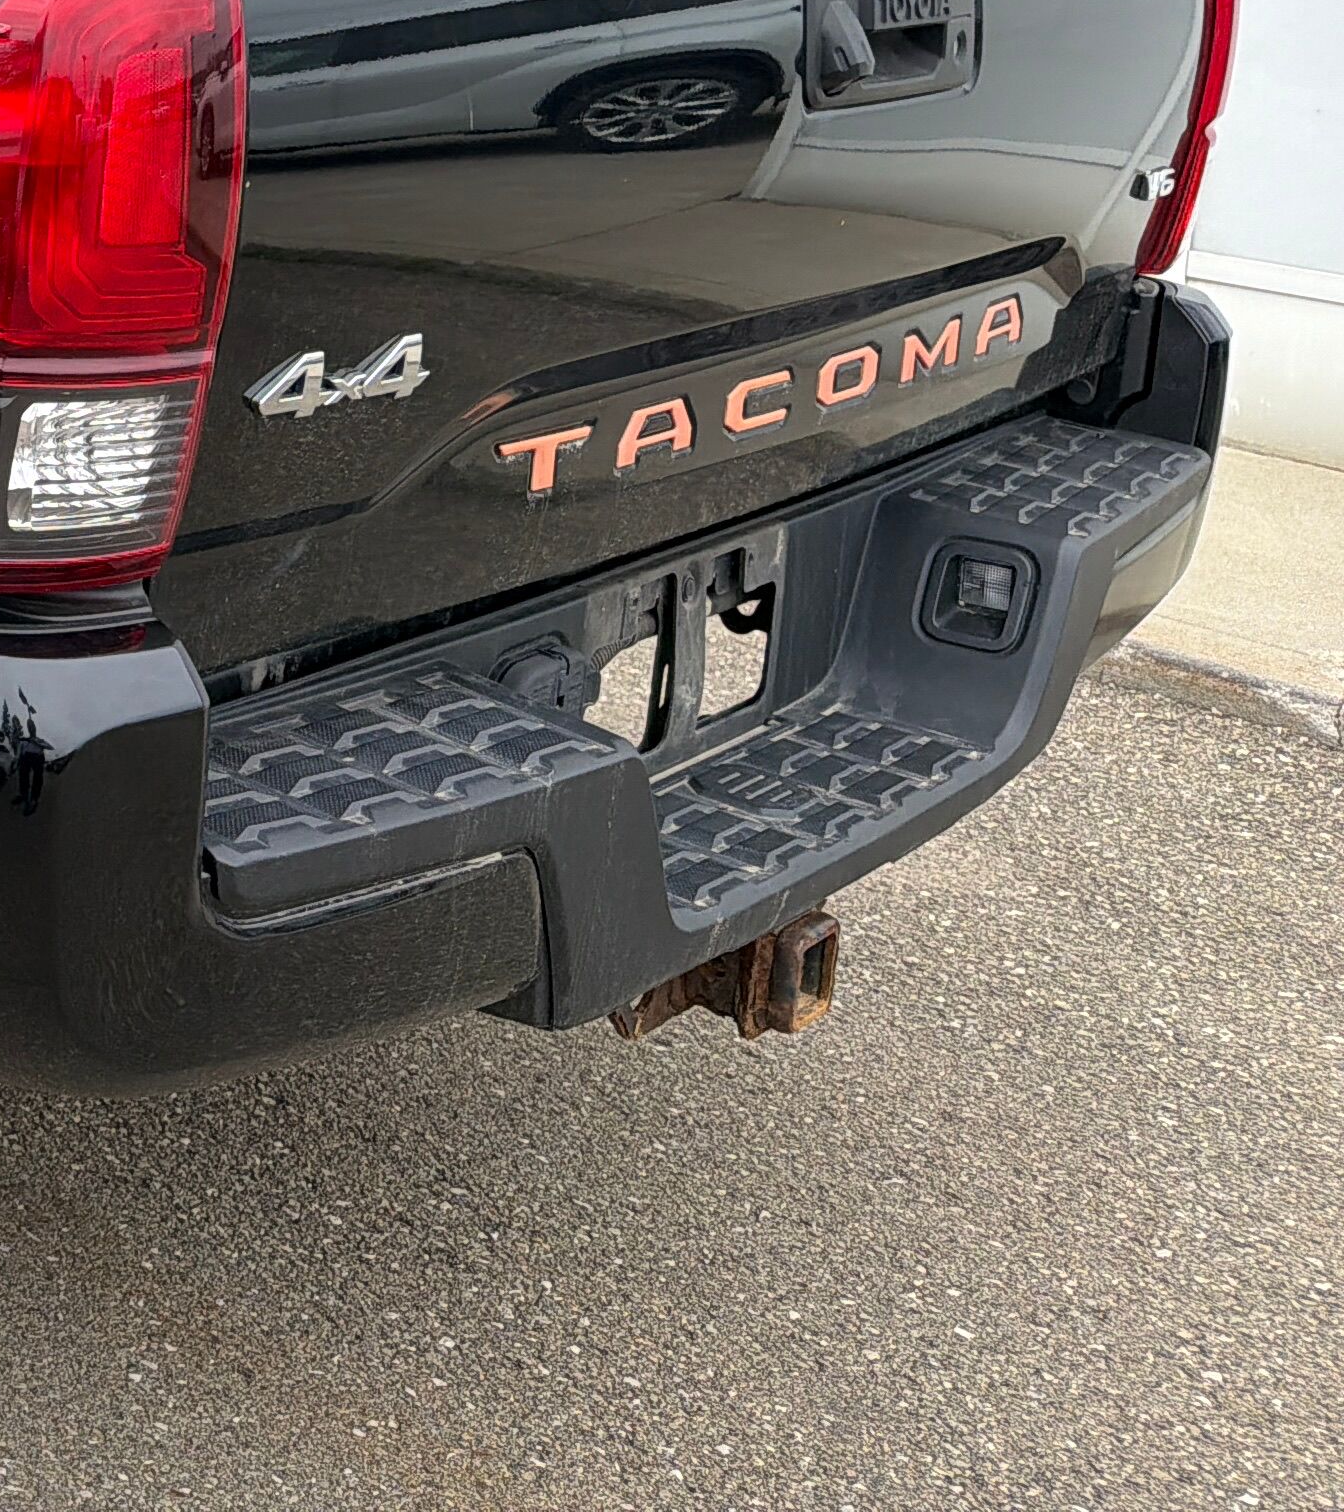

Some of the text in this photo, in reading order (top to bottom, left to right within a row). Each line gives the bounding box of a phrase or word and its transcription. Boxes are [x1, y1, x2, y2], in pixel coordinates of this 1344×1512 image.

[1136, 169, 1175, 200] V6
[243, 332, 432, 420] 4x4
[494, 294, 1024, 500] TACOMA
